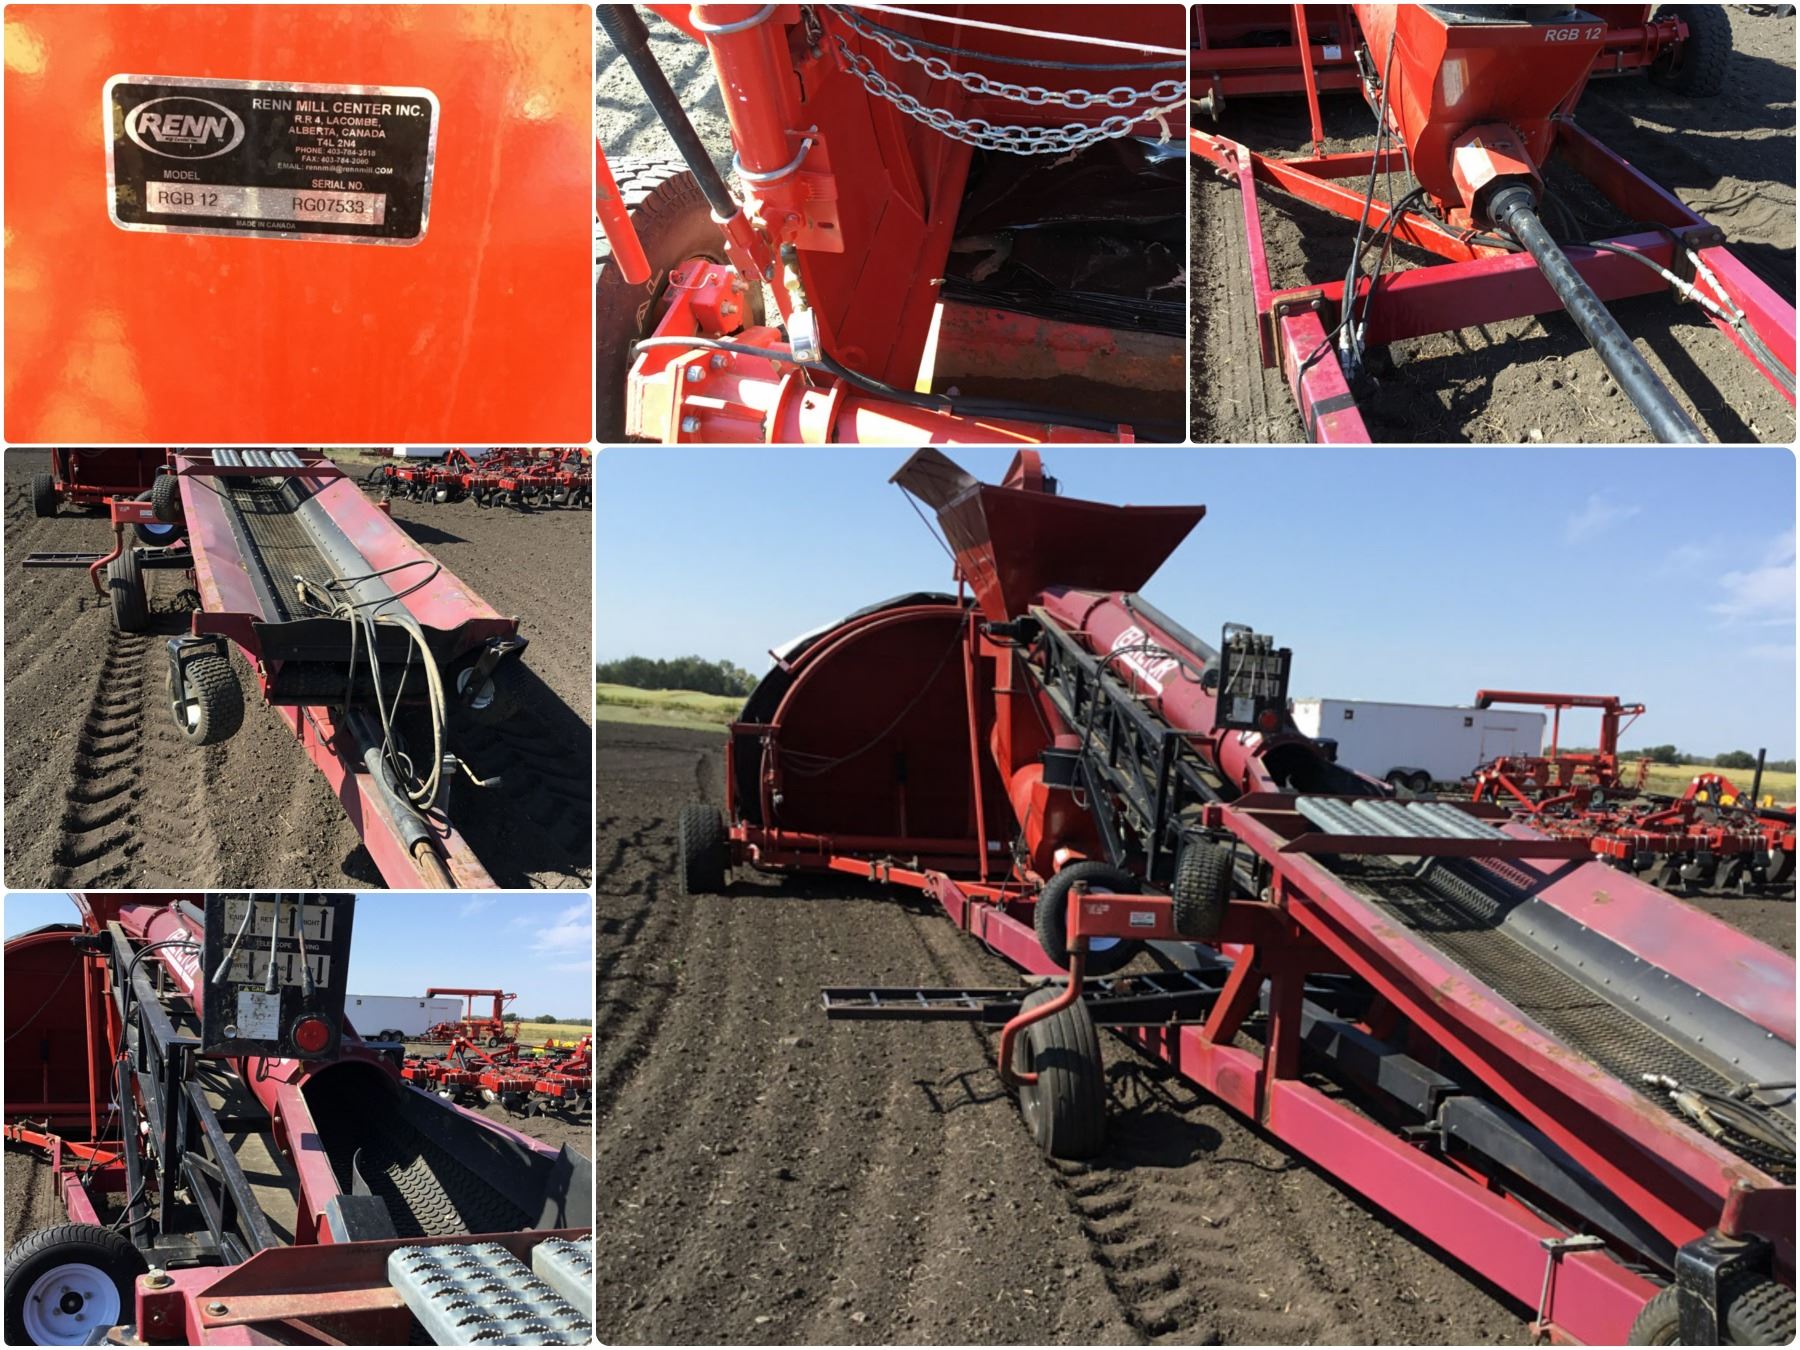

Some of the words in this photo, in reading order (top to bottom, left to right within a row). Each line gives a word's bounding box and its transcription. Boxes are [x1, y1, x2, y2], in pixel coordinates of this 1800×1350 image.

[1544, 29, 1579, 42] RGB
[1584, 27, 1602, 40] 12
[252, 98, 292, 111] RENN
[296, 100, 329, 113] MILL
[333, 102, 392, 115] CENTER
[395, 104, 425, 117] INC.
[138, 112, 227, 144] RENN
[326, 117, 381, 128] LACOMBE,
[288, 126, 339, 137] ALBERTA,
[341, 129, 386, 139] CANADA
[317, 138, 335, 147] T4L
[337, 139, 357, 148] 2N4
[295, 147, 325, 155] PHONE:
[163, 170, 201, 181] MODEL
[311, 179, 346, 190] SERIAL
[347, 180, 365, 191] NO.
[158, 191, 194, 206] RGB
[200, 192, 218, 207] 12
[292, 196, 365, 214] RG07533
[236, 219, 257, 228] MADE
[257, 220, 265, 228] IN
[266, 221, 296, 230] CANADA
